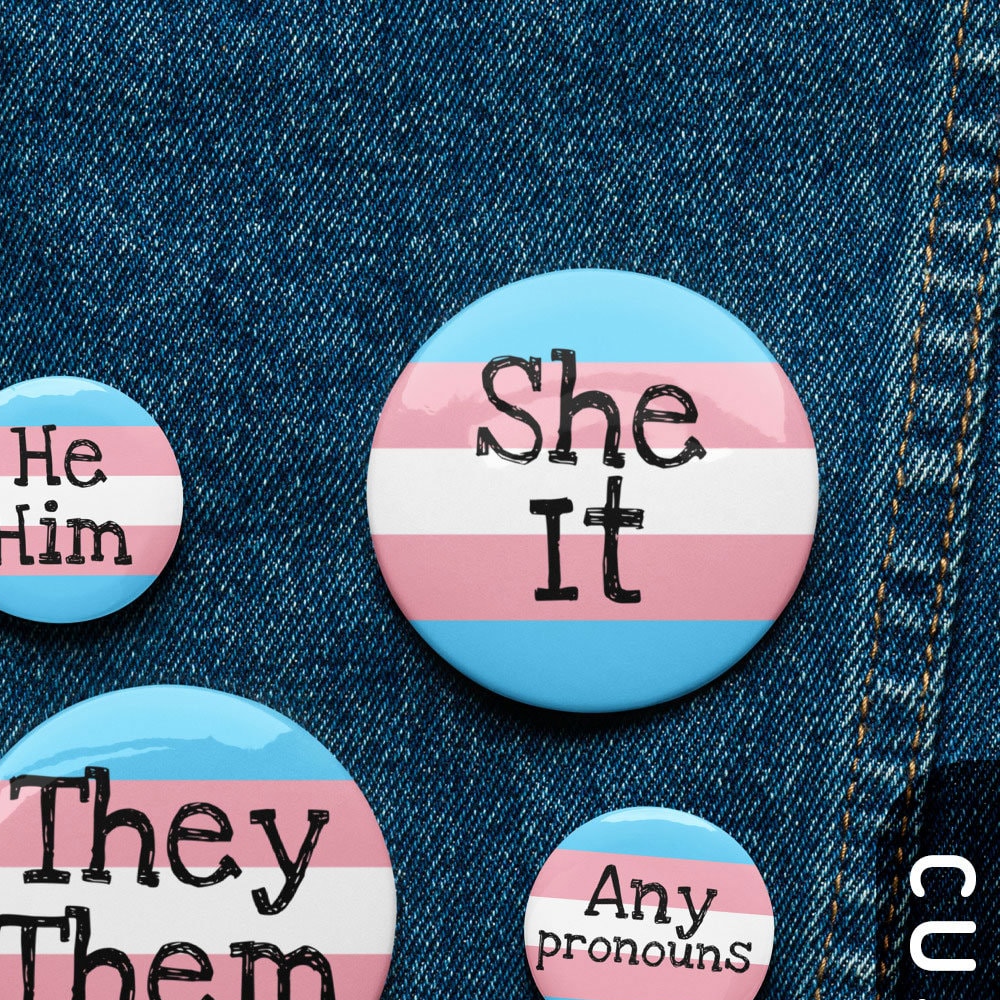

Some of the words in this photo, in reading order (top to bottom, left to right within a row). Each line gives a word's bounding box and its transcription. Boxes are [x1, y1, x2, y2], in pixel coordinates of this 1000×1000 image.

[10, 424, 108, 489] He
[475, 348, 707, 469] She
[529, 475, 645, 604] It
[9, 766, 329, 915] They
[536, 926, 752, 974] pronouns
[584, 865, 718, 941] Any
